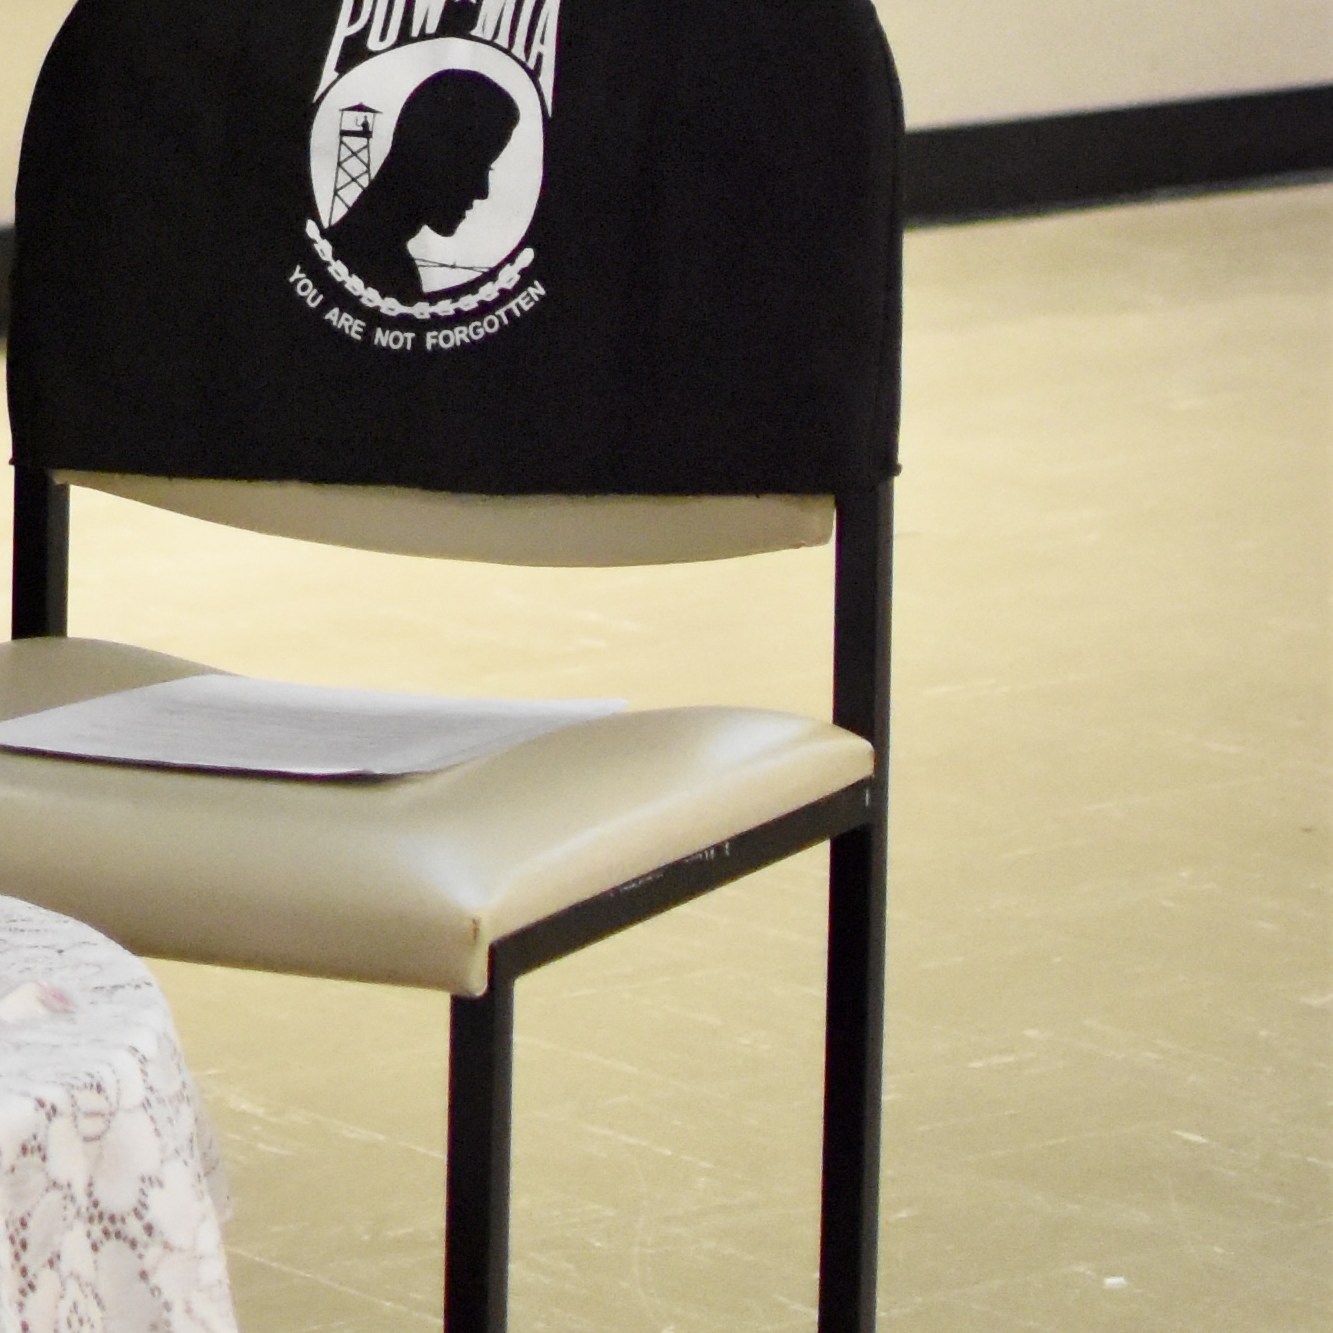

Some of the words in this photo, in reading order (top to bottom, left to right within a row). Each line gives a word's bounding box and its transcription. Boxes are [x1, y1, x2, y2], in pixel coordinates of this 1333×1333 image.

[287, 264, 322, 310] YOU
[324, 305, 367, 341] ARE
[373, 326, 416, 352] NOT
[425, 279, 547, 351] FORGOTTEN
